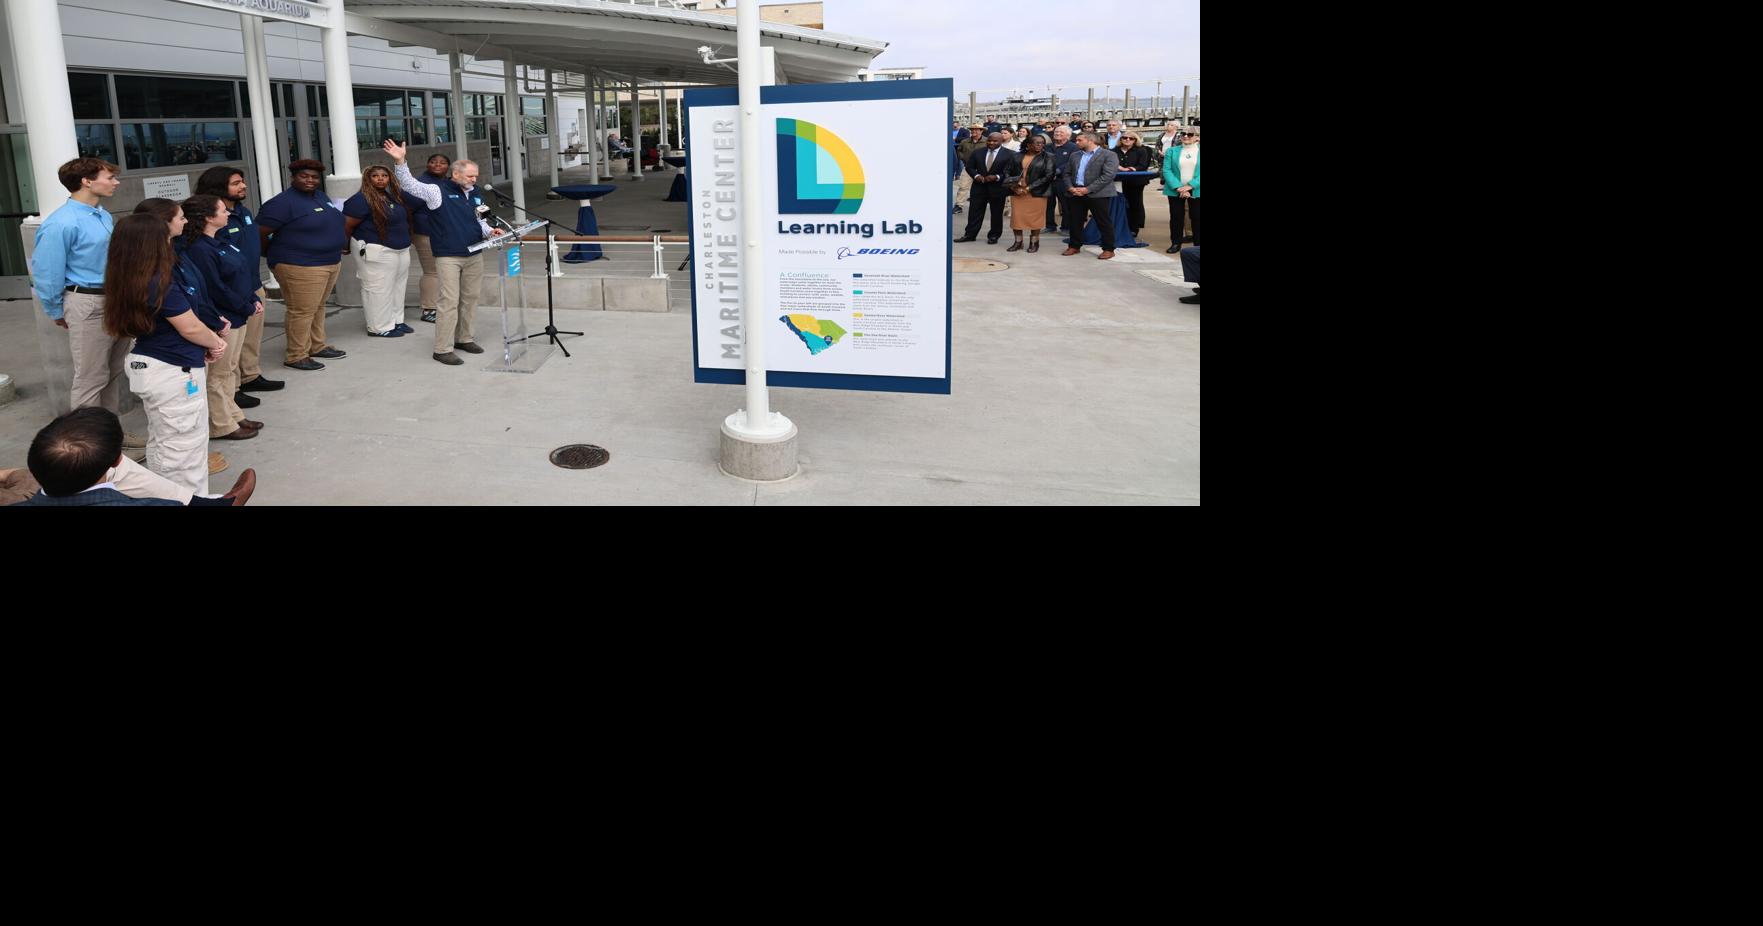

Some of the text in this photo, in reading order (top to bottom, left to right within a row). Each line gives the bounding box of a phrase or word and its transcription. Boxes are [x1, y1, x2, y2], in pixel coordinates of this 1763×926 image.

[251, 0, 311, 18] AQUARIUM
[702, 189, 714, 289] CHARLESTON
[713, 120, 741, 359] MARITIME CENTER
[778, 219, 923, 238] Learning Lab
